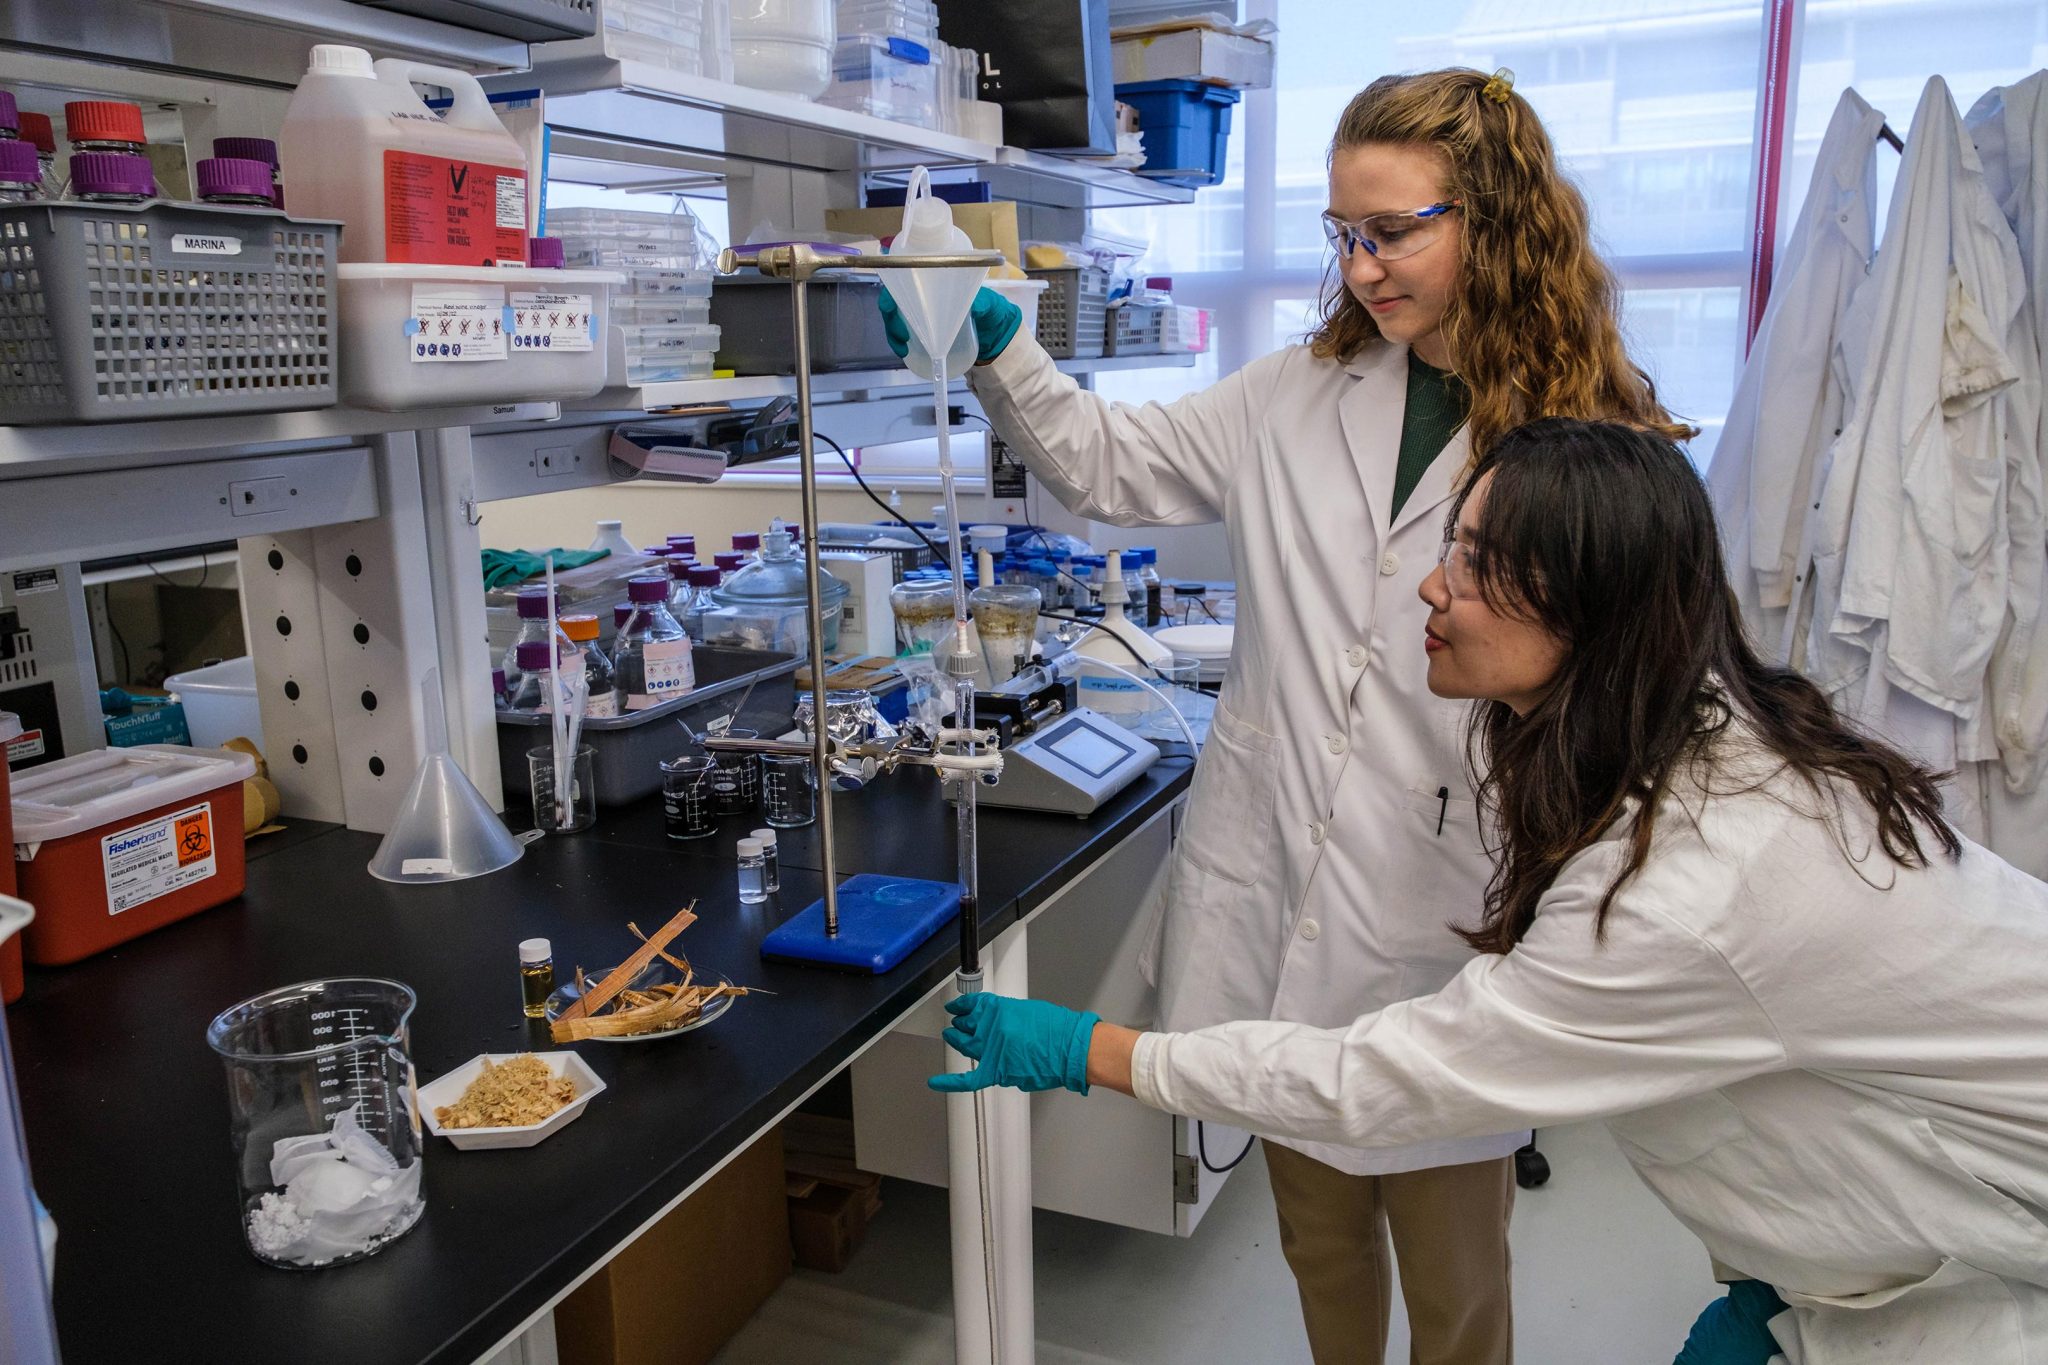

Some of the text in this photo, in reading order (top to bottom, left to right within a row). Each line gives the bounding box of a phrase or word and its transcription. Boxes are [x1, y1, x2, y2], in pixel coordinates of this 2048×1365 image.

[447, 205, 469, 218] RED WINE
[184, 238, 226, 250] MARINA
[493, 405, 516, 415] Samuel
[109, 711, 161, 731] TouchNTuff
[180, 814, 202, 827] DANGER
[109, 829, 166, 855] Fisherbrand
[111, 864, 137, 878] REGULATED
[138, 857, 158, 869] MEDICAL
[158, 851, 173, 861] WASTE
[179, 850, 211, 867] BIOHAZARD
